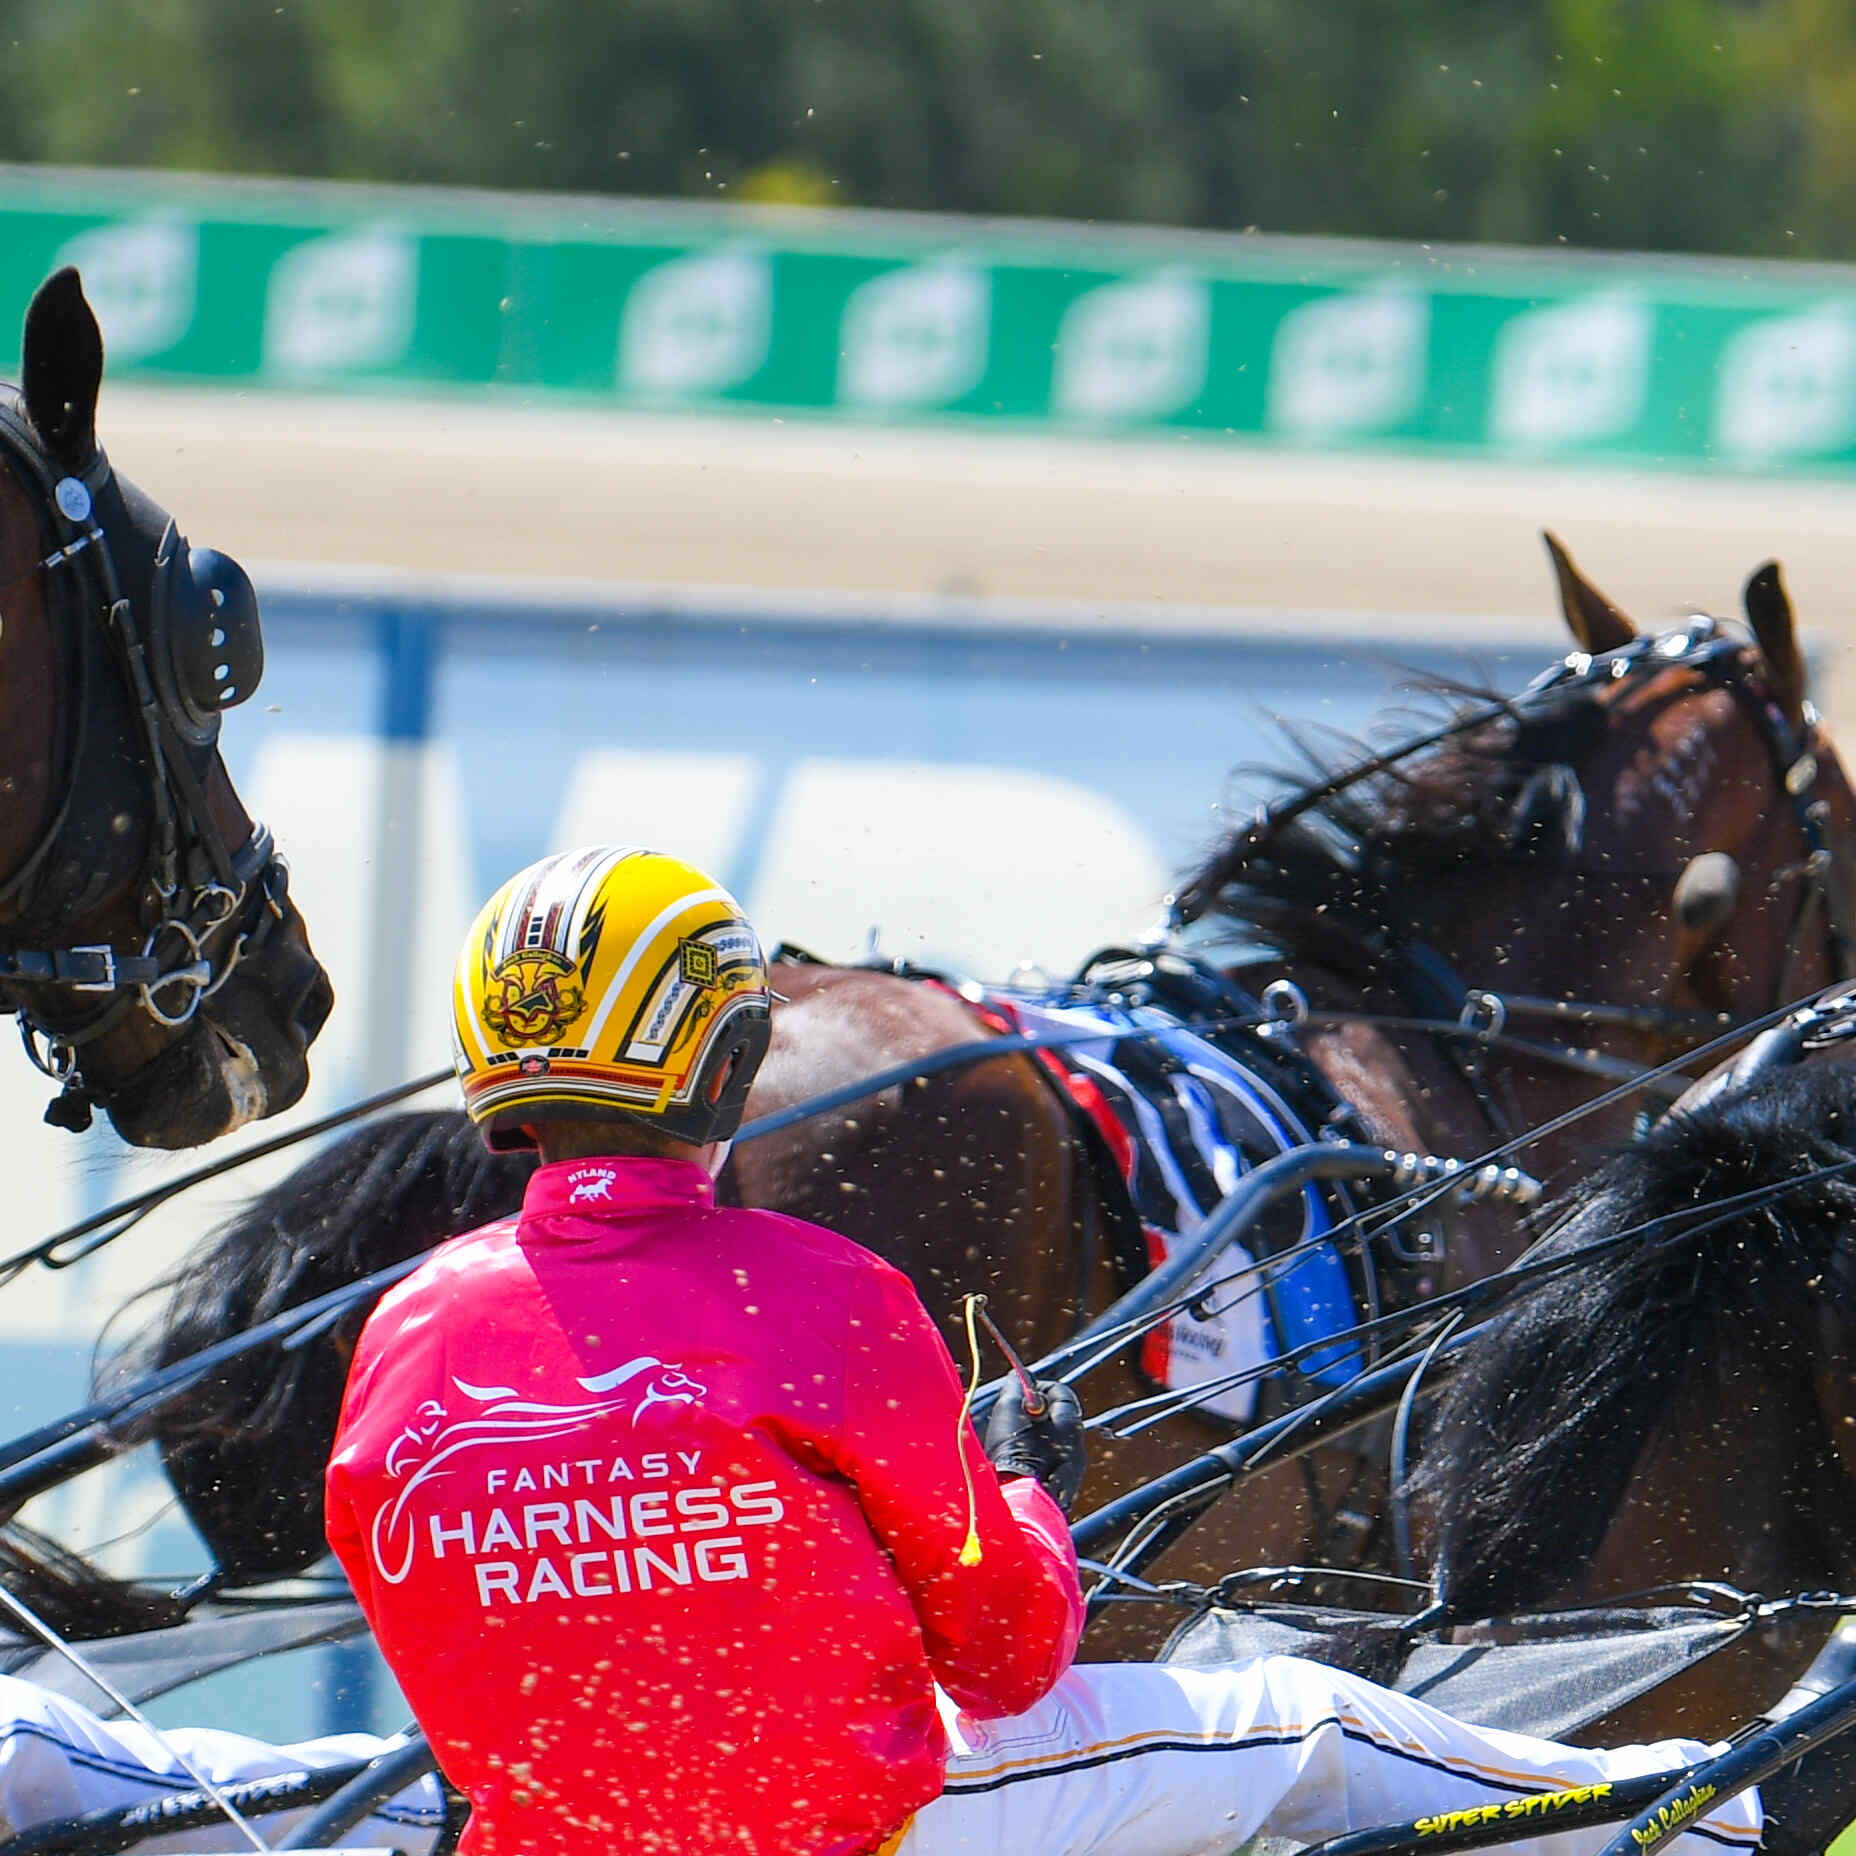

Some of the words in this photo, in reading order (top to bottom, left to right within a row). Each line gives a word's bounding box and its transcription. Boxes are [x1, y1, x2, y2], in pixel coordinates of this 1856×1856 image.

[486, 1450, 702, 1494] FANTASY
[430, 1480, 785, 1559] HARNESS
[474, 1536, 749, 1607] RACING
[1413, 1803, 1503, 1838] SUPER
[1503, 1782, 1614, 1818] SPYDER
